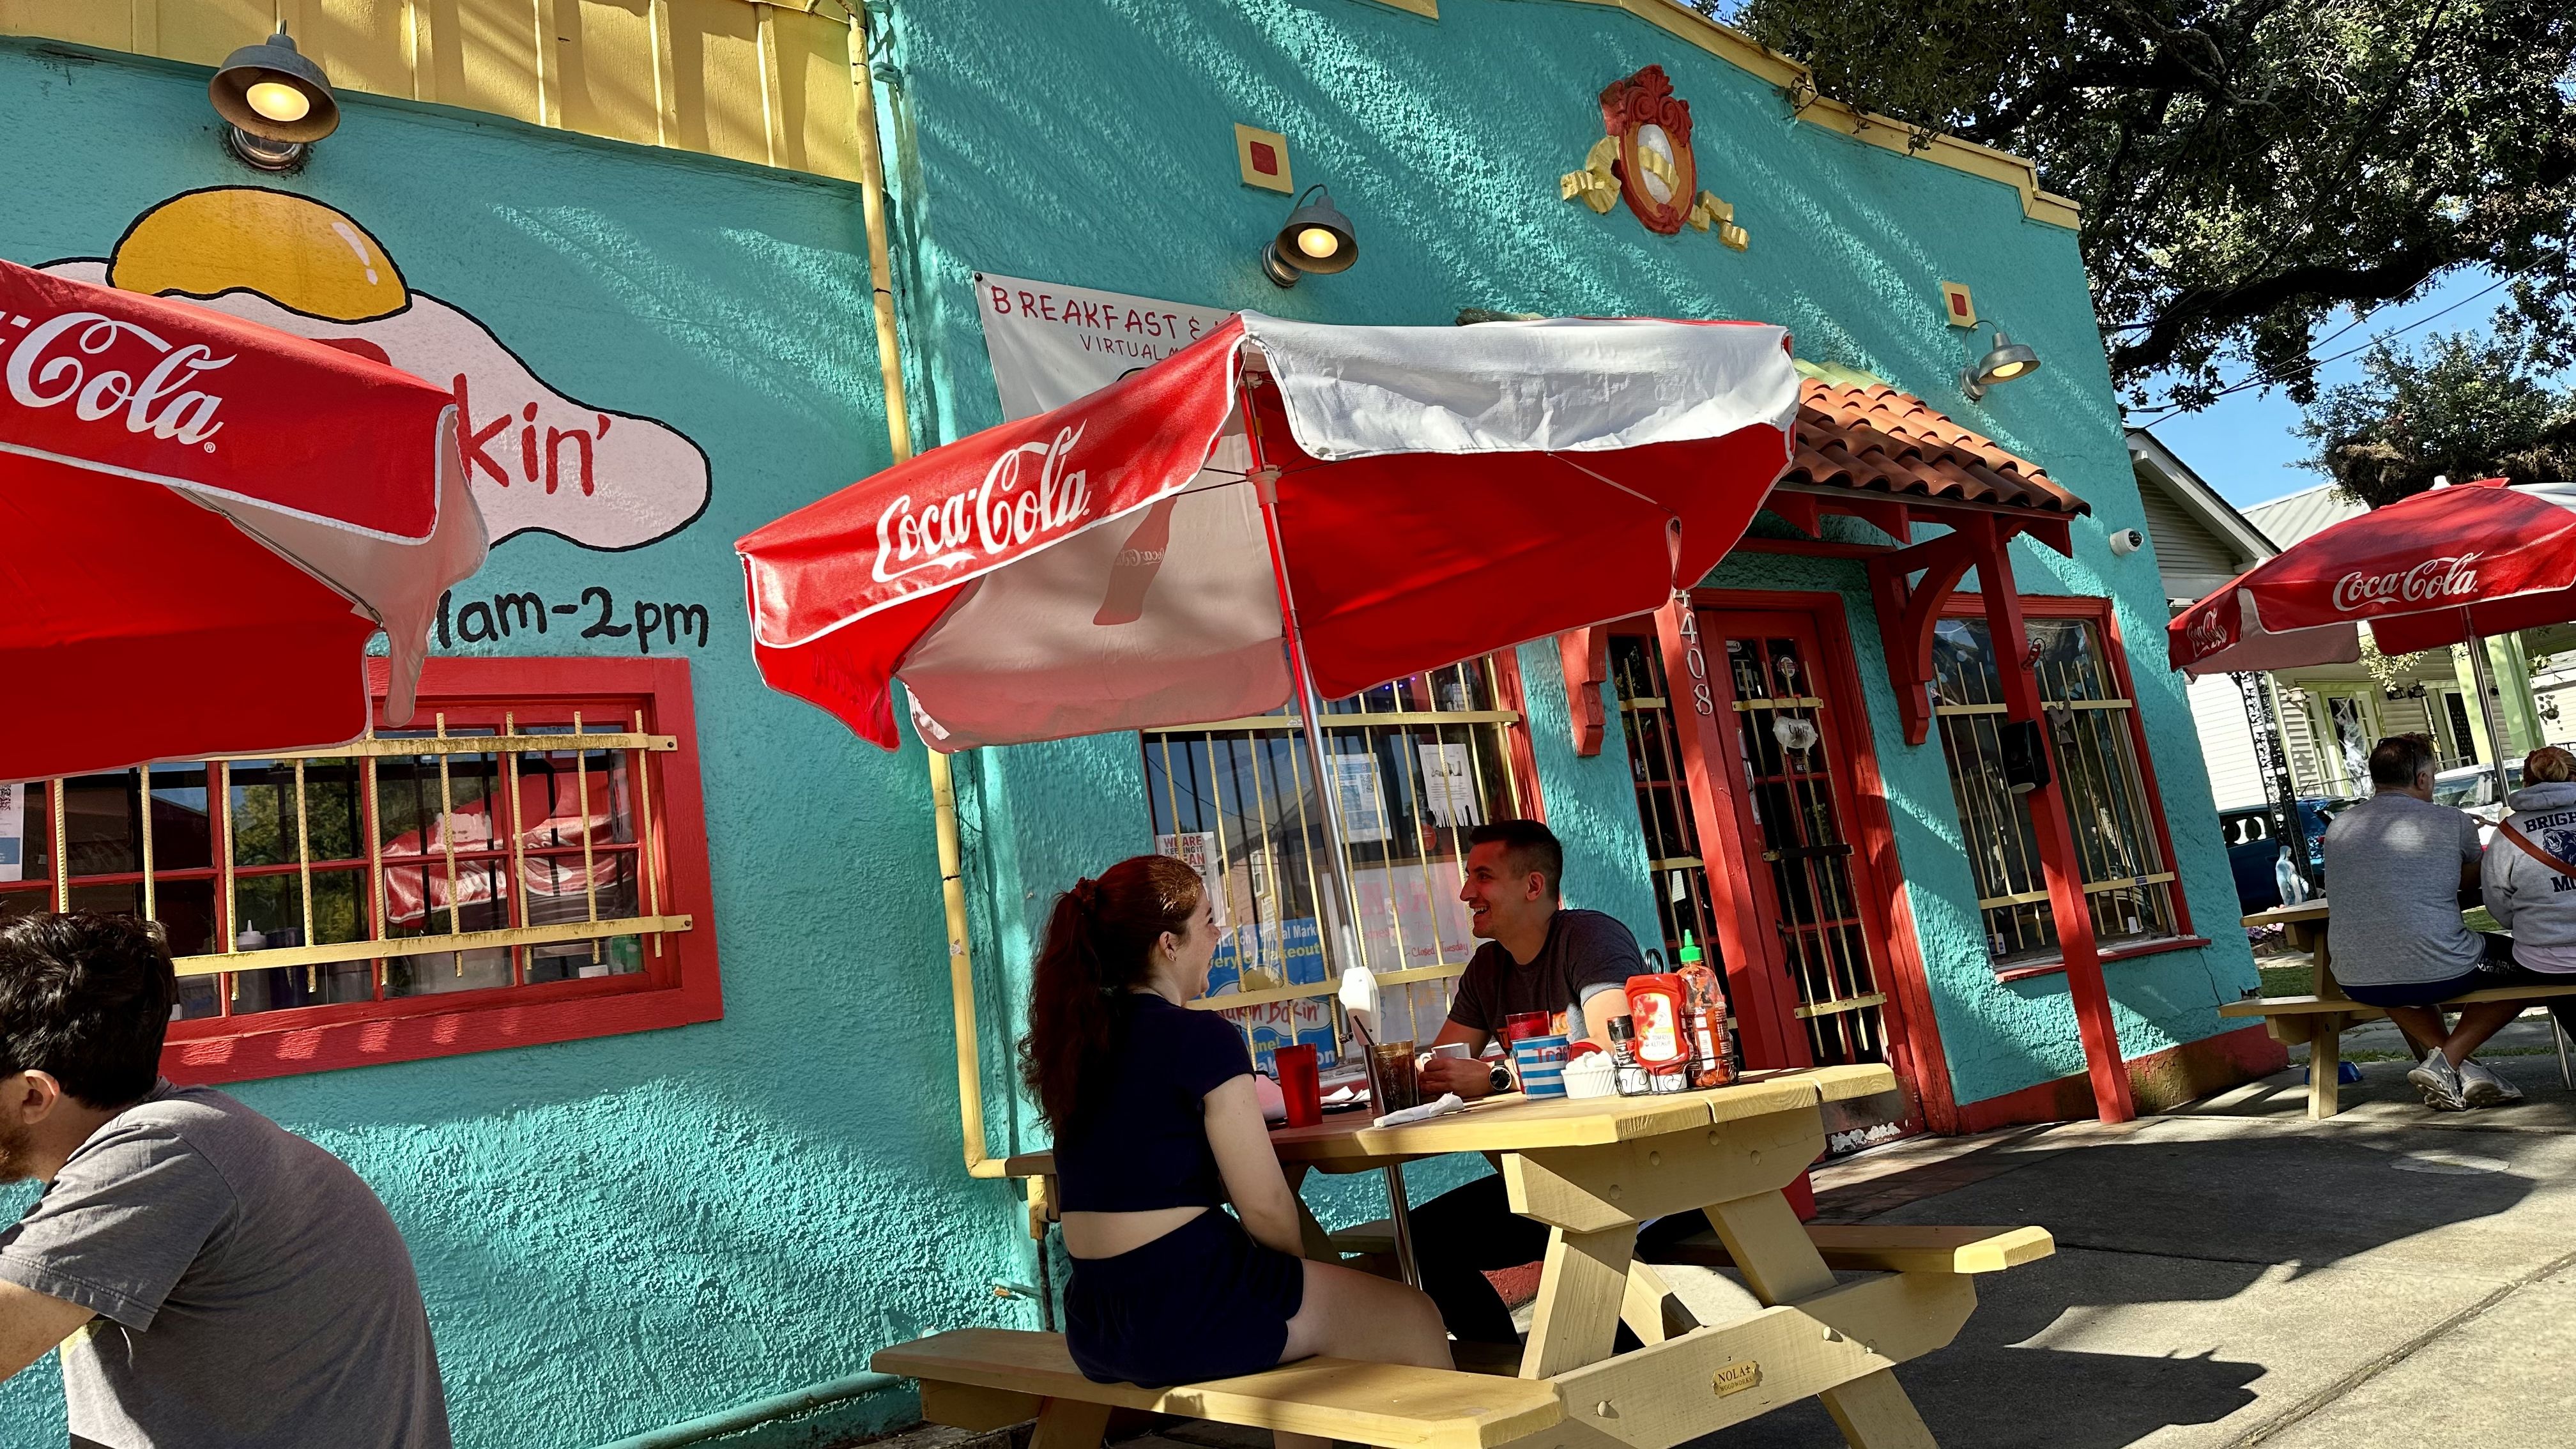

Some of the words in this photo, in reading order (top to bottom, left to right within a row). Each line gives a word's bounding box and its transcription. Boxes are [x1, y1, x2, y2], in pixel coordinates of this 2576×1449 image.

[991, 286, 1177, 339] BREAKFAST
[1188, 316, 1200, 340] &
[1080, 334, 1162, 361] VIRTUAL
[0, 310, 238, 445] -Cola
[452, 372, 611, 497] kin'
[871, 418, 1091, 583] Coca-Cola
[2332, 550, 2485, 612] Coca-Cola
[1165, 846, 1195, 855] KEEING
[1183, 836, 1202, 847] ARE
[1221, 931, 1252, 947] Luch
[1292, 923, 1318, 939] Mark
[1258, 942, 1321, 962] Taeout
[1411, 943, 1435, 957] Closed
[1440, 940, 1469, 956] Tuesday
[1254, 1036, 1281, 1053] ine!
[1717, 1366, 1747, 1384] NOLA
[1719, 1377, 1754, 1392] WOODWORKS
